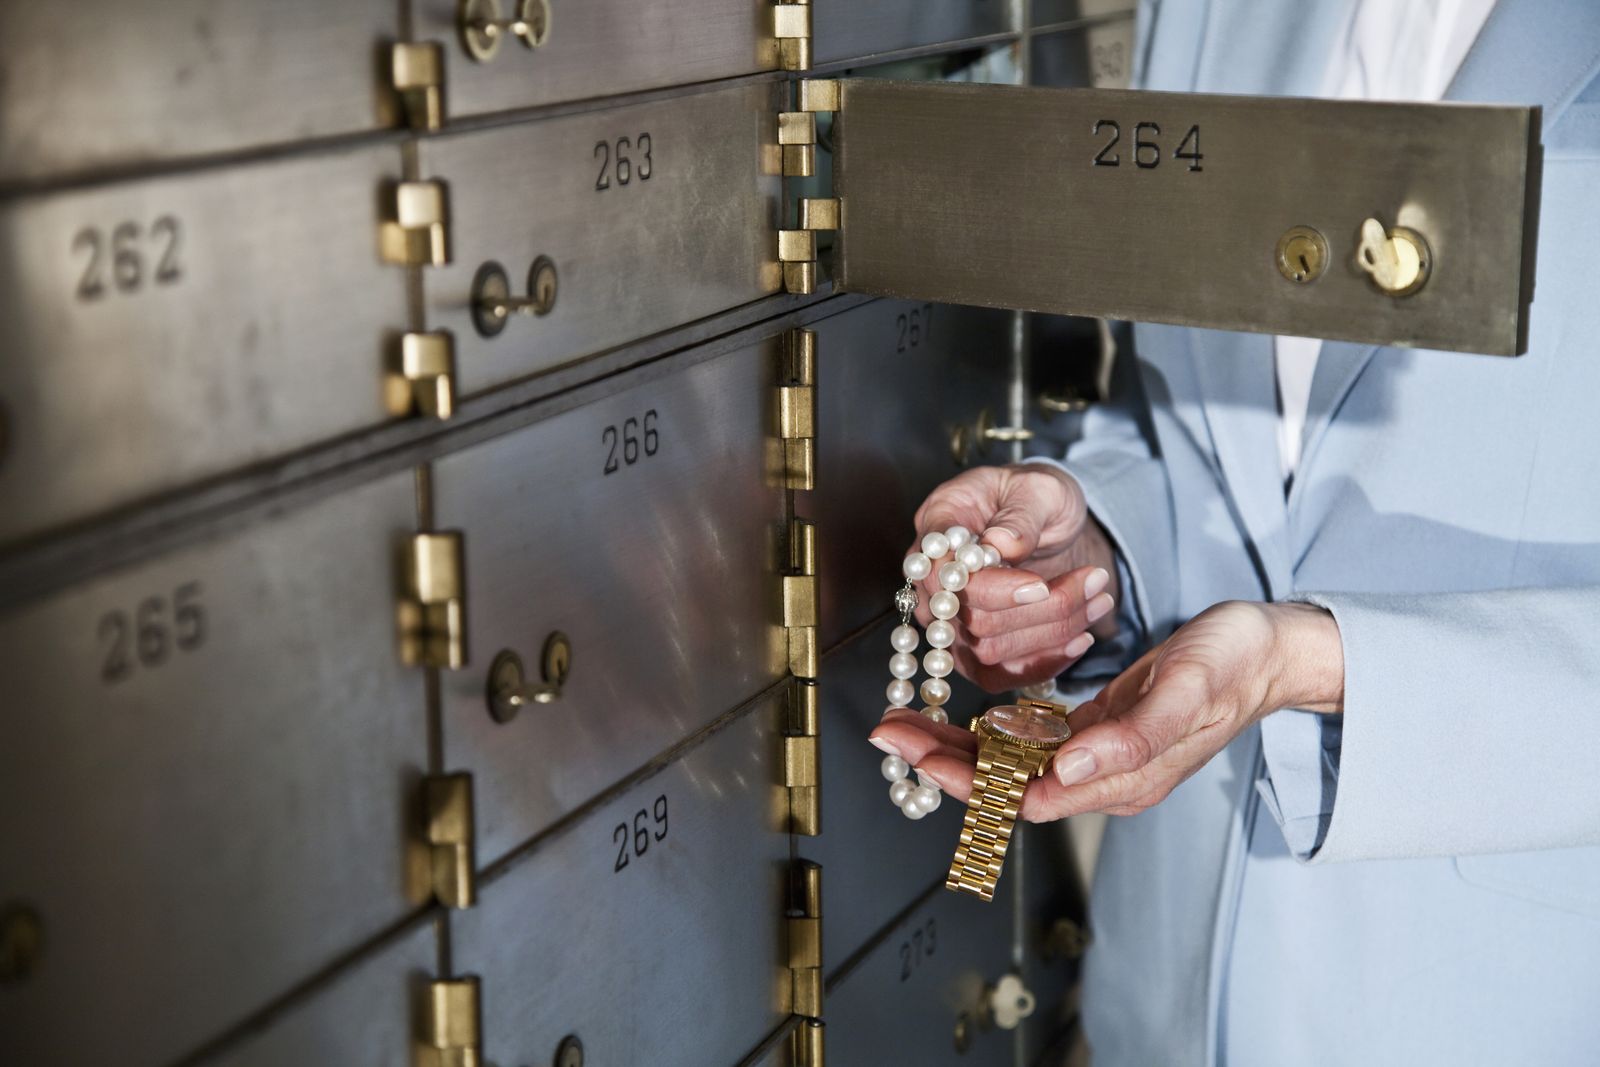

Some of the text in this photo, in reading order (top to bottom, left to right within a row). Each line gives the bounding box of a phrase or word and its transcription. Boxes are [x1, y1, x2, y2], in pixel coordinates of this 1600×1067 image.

[593, 132, 651, 191] 263
[1091, 118, 1204, 172] 264
[71, 213, 182, 303] 262
[602, 408, 658, 476] 266
[97, 580, 208, 685] 265
[613, 794, 668, 873] 269
